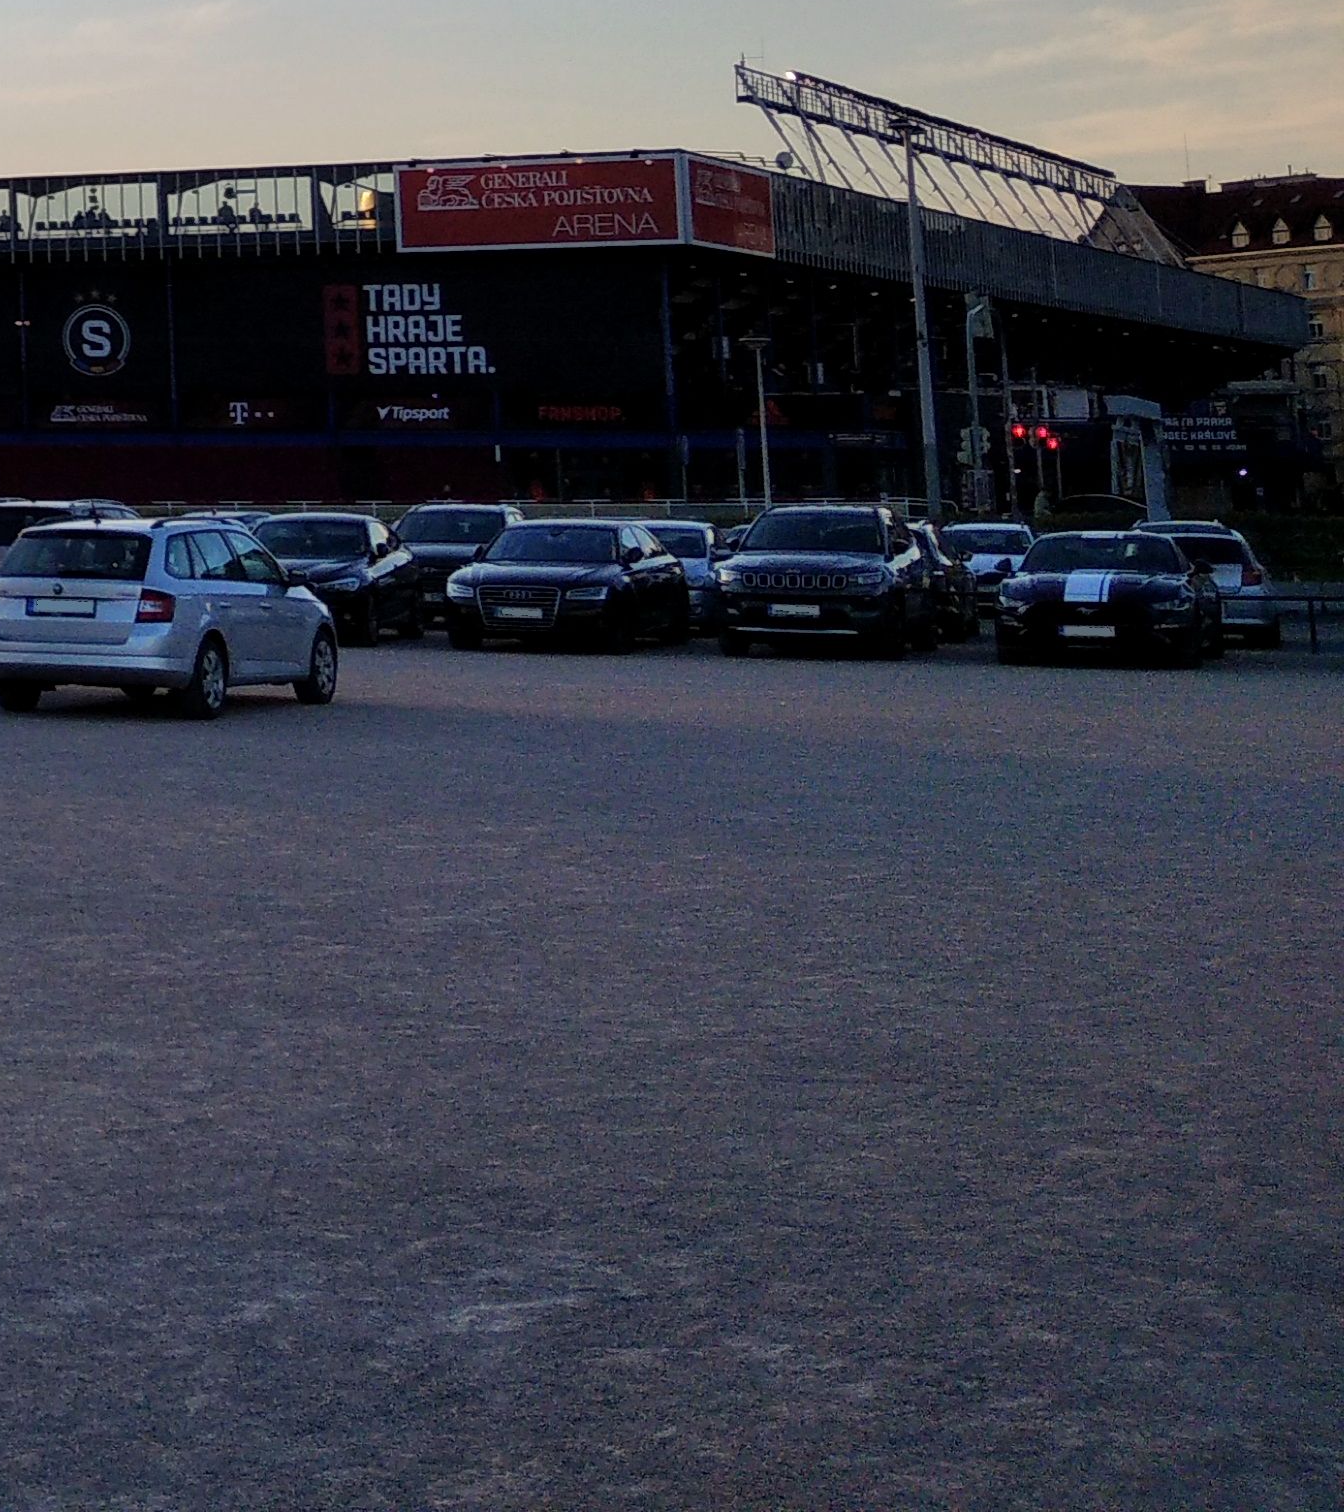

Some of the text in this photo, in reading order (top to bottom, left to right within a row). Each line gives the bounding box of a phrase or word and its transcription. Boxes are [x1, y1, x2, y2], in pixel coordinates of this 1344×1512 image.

[480, 170, 568, 189] GENERALI
[482, 188, 539, 208] ČESKÁ
[552, 212, 659, 237] ARENA
[362, 283, 441, 311] TADY
[81, 319, 111, 357] S
[365, 314, 464, 343] HRAJE
[368, 345, 497, 375] SPARTA.
